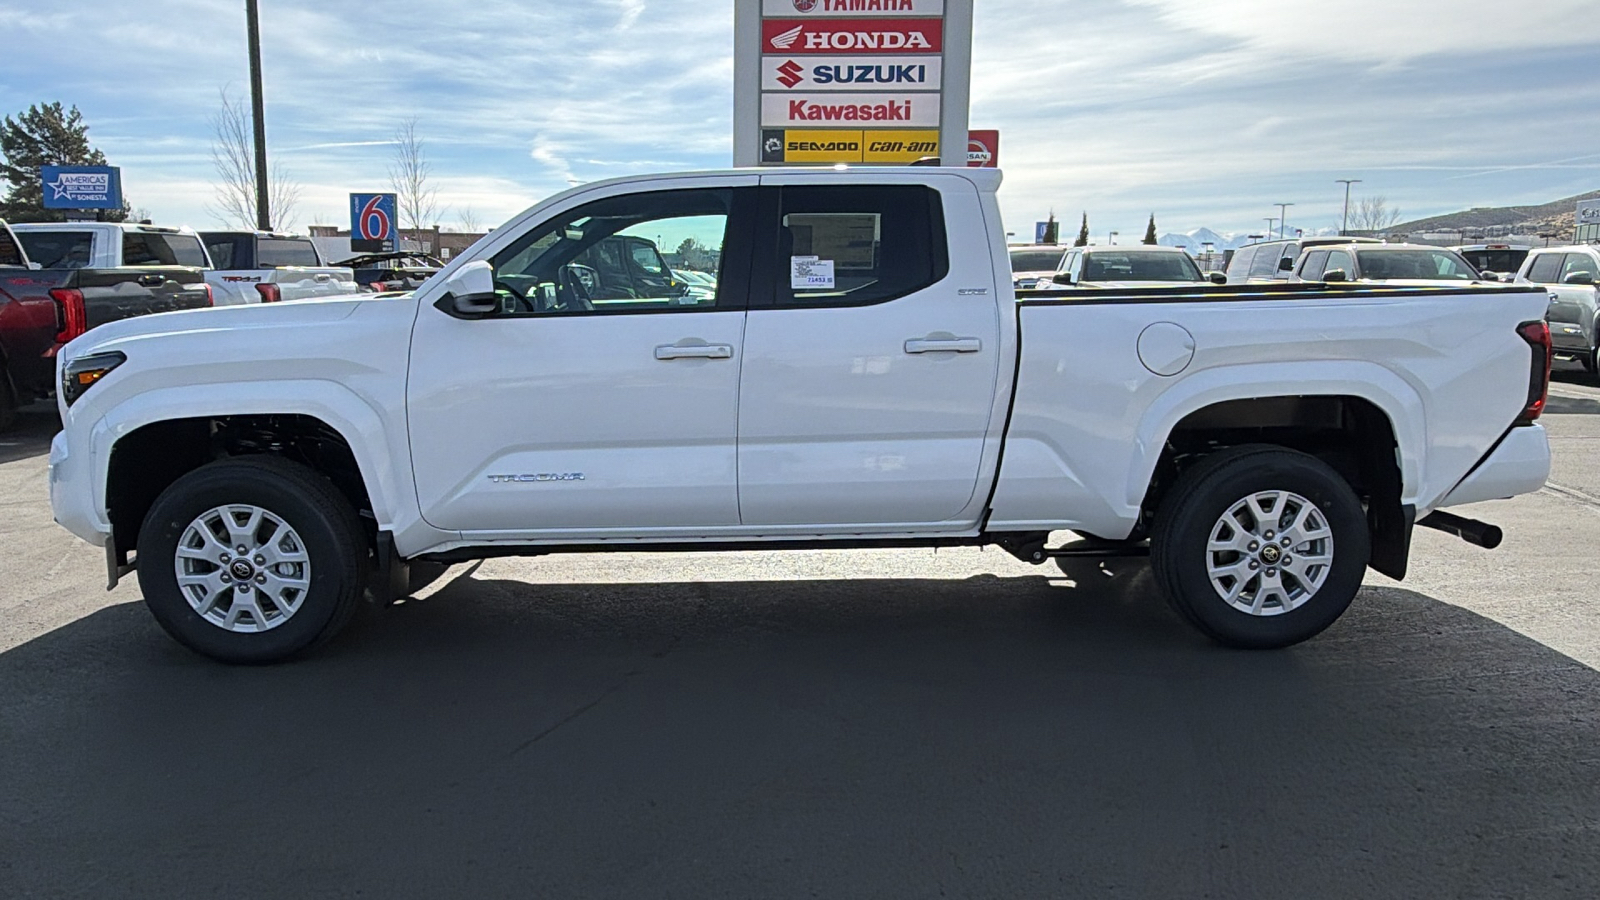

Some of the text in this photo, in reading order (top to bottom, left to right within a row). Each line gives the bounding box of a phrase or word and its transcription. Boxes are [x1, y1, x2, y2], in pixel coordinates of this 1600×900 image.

[823, 0, 913, 11] YAMAHA
[804, 31, 932, 49] HONDA
[812, 64, 925, 83] SUZUKI
[788, 99, 912, 121] Kawasaki
[65, 176, 105, 184] AMERICAS
[359, 194, 390, 241] 6
[488, 473, 585, 483] TACOMA
